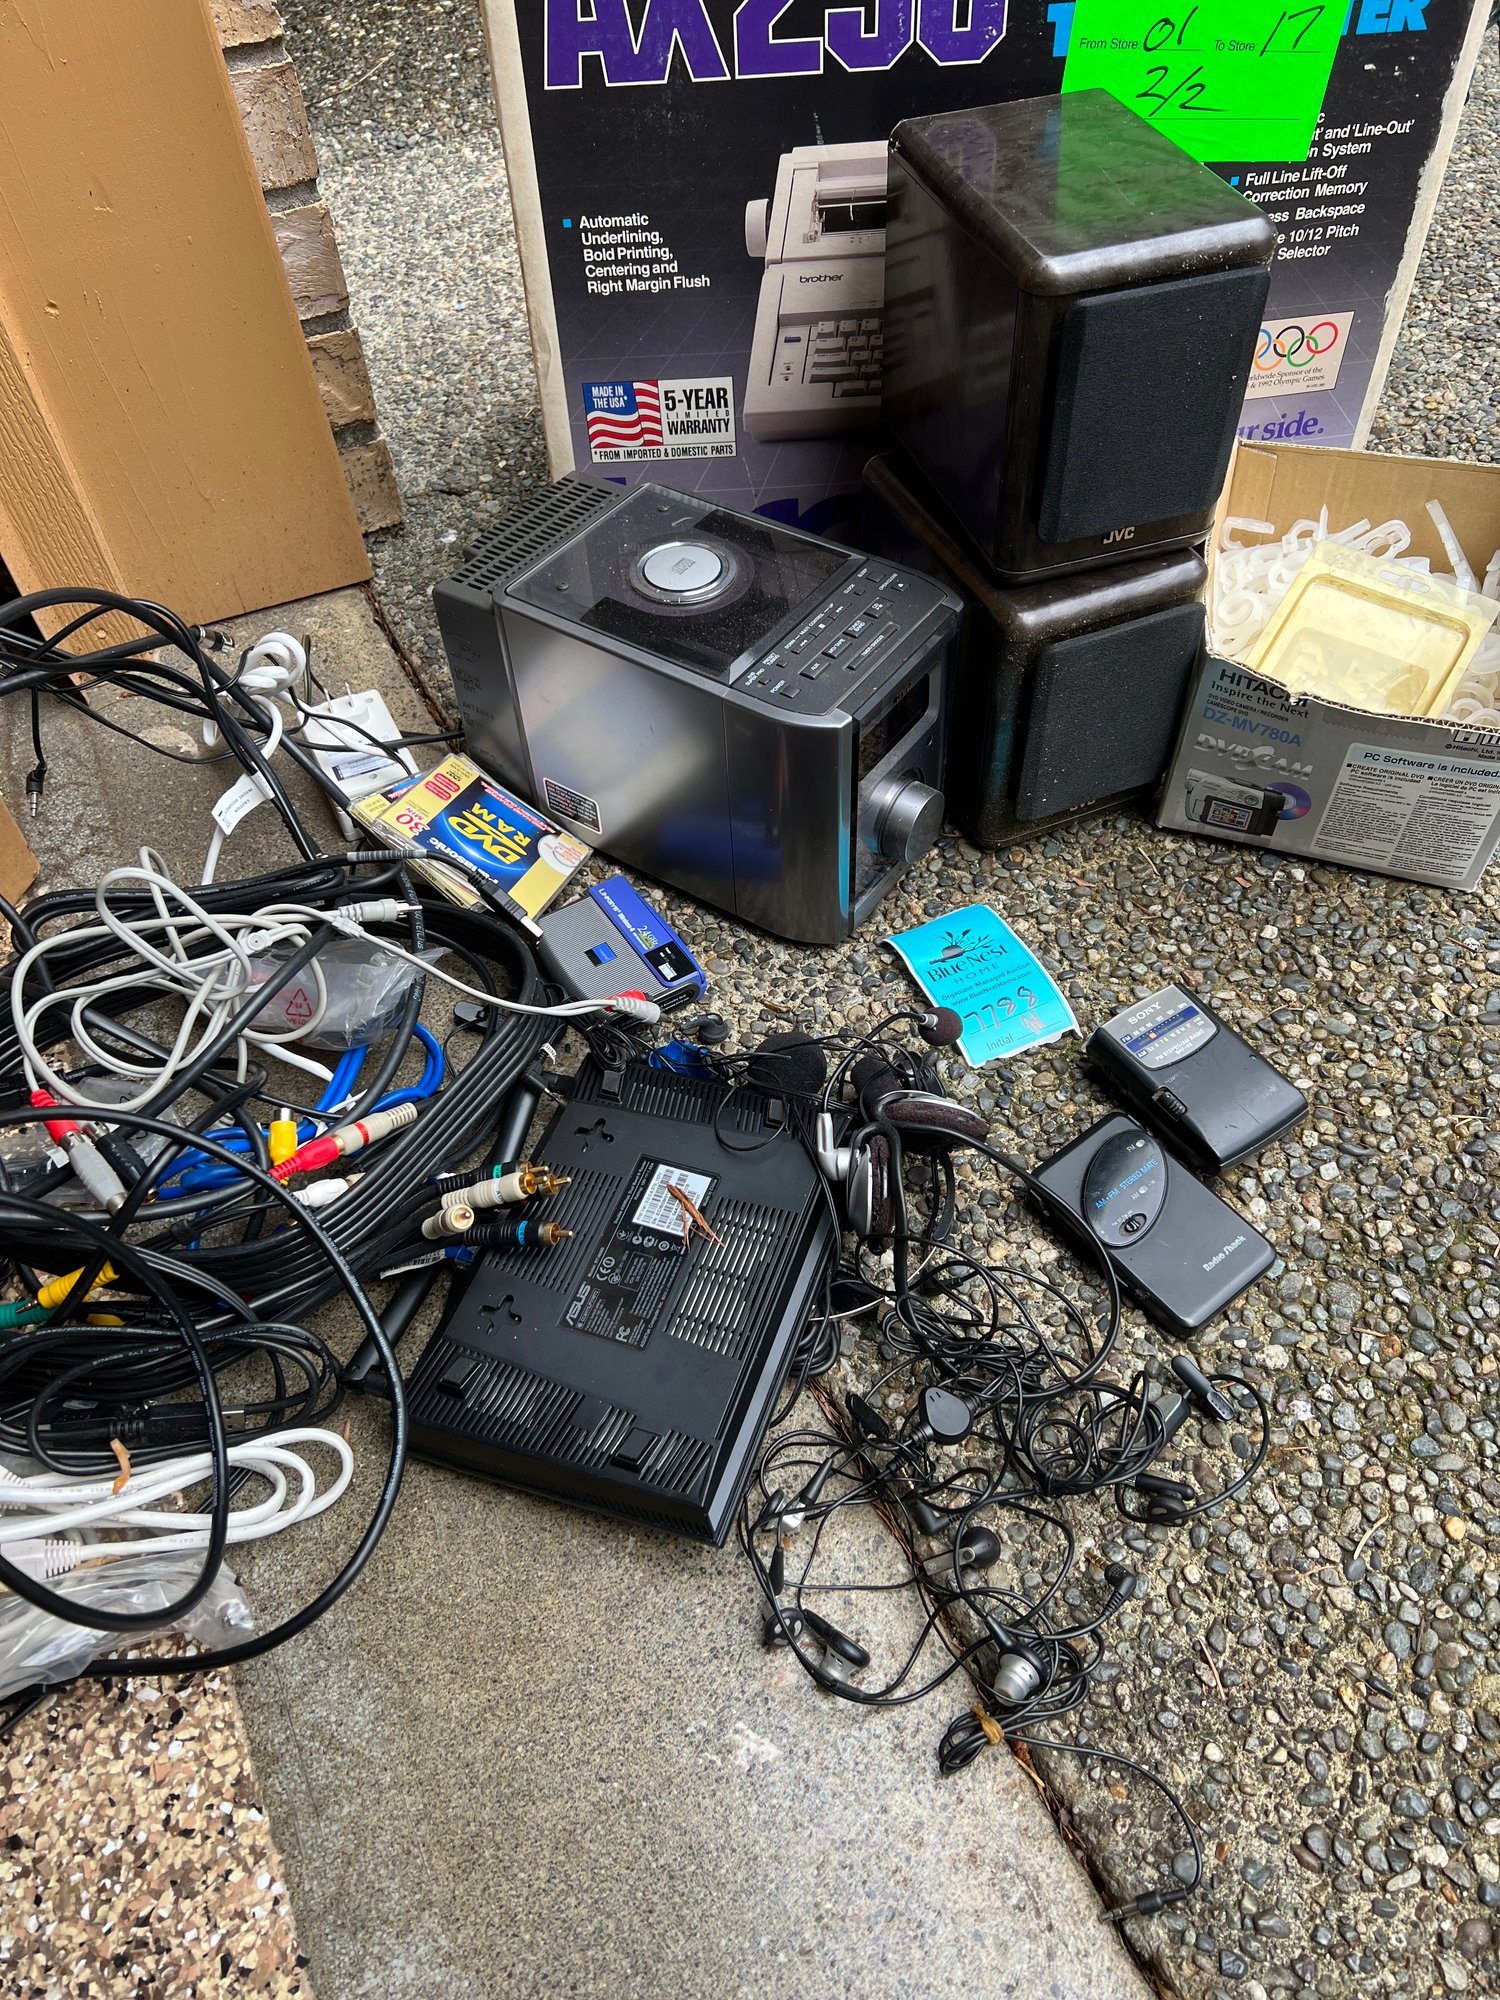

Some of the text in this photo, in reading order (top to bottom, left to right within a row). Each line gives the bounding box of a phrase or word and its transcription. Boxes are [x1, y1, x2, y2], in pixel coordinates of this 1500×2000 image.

[1079, 37, 1142, 51] From Store:
[1214, 40, 1259, 52] To Store:
[1135, 65, 1230, 118] 2/2
[1326, 125, 1350, 140] and
[1322, 142, 1371, 160] System
[1245, 165, 1348, 187] Full Line Lift-Off
[1243, 181, 1369, 203] Correction Memory
[579, 212, 649, 229] Automatic
[1295, 203, 1366, 221] Backspace
[581, 229, 664, 246] Underlining,
[1289, 225, 1360, 244] 10/12 Pitch
[583, 245, 674, 262] Bold Printing,
[1277, 245, 1331, 261] Selector
[585, 260, 678, 278] Centering and
[587, 274, 711, 296] Right Margin Flush
[799, 274, 844, 283] brother
[1258, 380, 1272, 388] 1992
[1273, 377, 1300, 389] Olympic
[1302, 374, 1325, 383] Games
[1277, 370, 1303, 381] Sponsor
[1304, 367, 1312, 375] of
[1312, 366, 1323, 374] the
[592, 385, 624, 397] MADE IN
[664, 387, 729, 411] 5-YEAR
[592, 397, 610, 409] THE
[666, 410, 730, 420] LIMITED
[667, 418, 730, 436] WARRANTY
[1261, 410, 1324, 440] side.
[623, 447, 662, 460] IMPORTED
[663, 447, 669, 458] &
[671, 446, 708, 457] DOMESTIC
[710, 444, 734, 456] PARTS
[1103, 526, 1135, 545] JVC
[1220, 668, 1309, 708] HITAC
[1211, 681, 1311, 719] Inspire the Next
[1219, 696, 1235, 706] VIDEO
[1235, 702, 1257, 714] CAMERA
[1260, 709, 1289, 722] RECORDER
[1202, 706, 1303, 748] DZ-MV780A
[1352, 764, 1425, 780] CREATE ORIGINAL DVD
[1363, 751, 1500, 778] PC Software is included.
[1360, 770, 1387, 779] software
[396, 813, 430, 836] 30
[471, 802, 532, 848] RAM
[448, 815, 521, 865] DVD
[941, 961, 1033, 1001] Organizer Managed Auction
[954, 963, 1001, 985] HOME
[951, 970, 1033, 1007] www.BlueNestHome.com
[1128, 1001, 1162, 1025] SONY
[986, 1033, 1014, 1052] Initial
[1121, 1035, 1132, 1043] FM
[1137, 1050, 1148, 1058] AM
[1126, 1143, 1136, 1153] FM
[1119, 1158, 1159, 1190] STEREO MATE
[1130, 1192, 1140, 1201] AM
[1202, 1235, 1247, 1272] Radio Shack
[565, 1281, 591, 1326] ASUS
